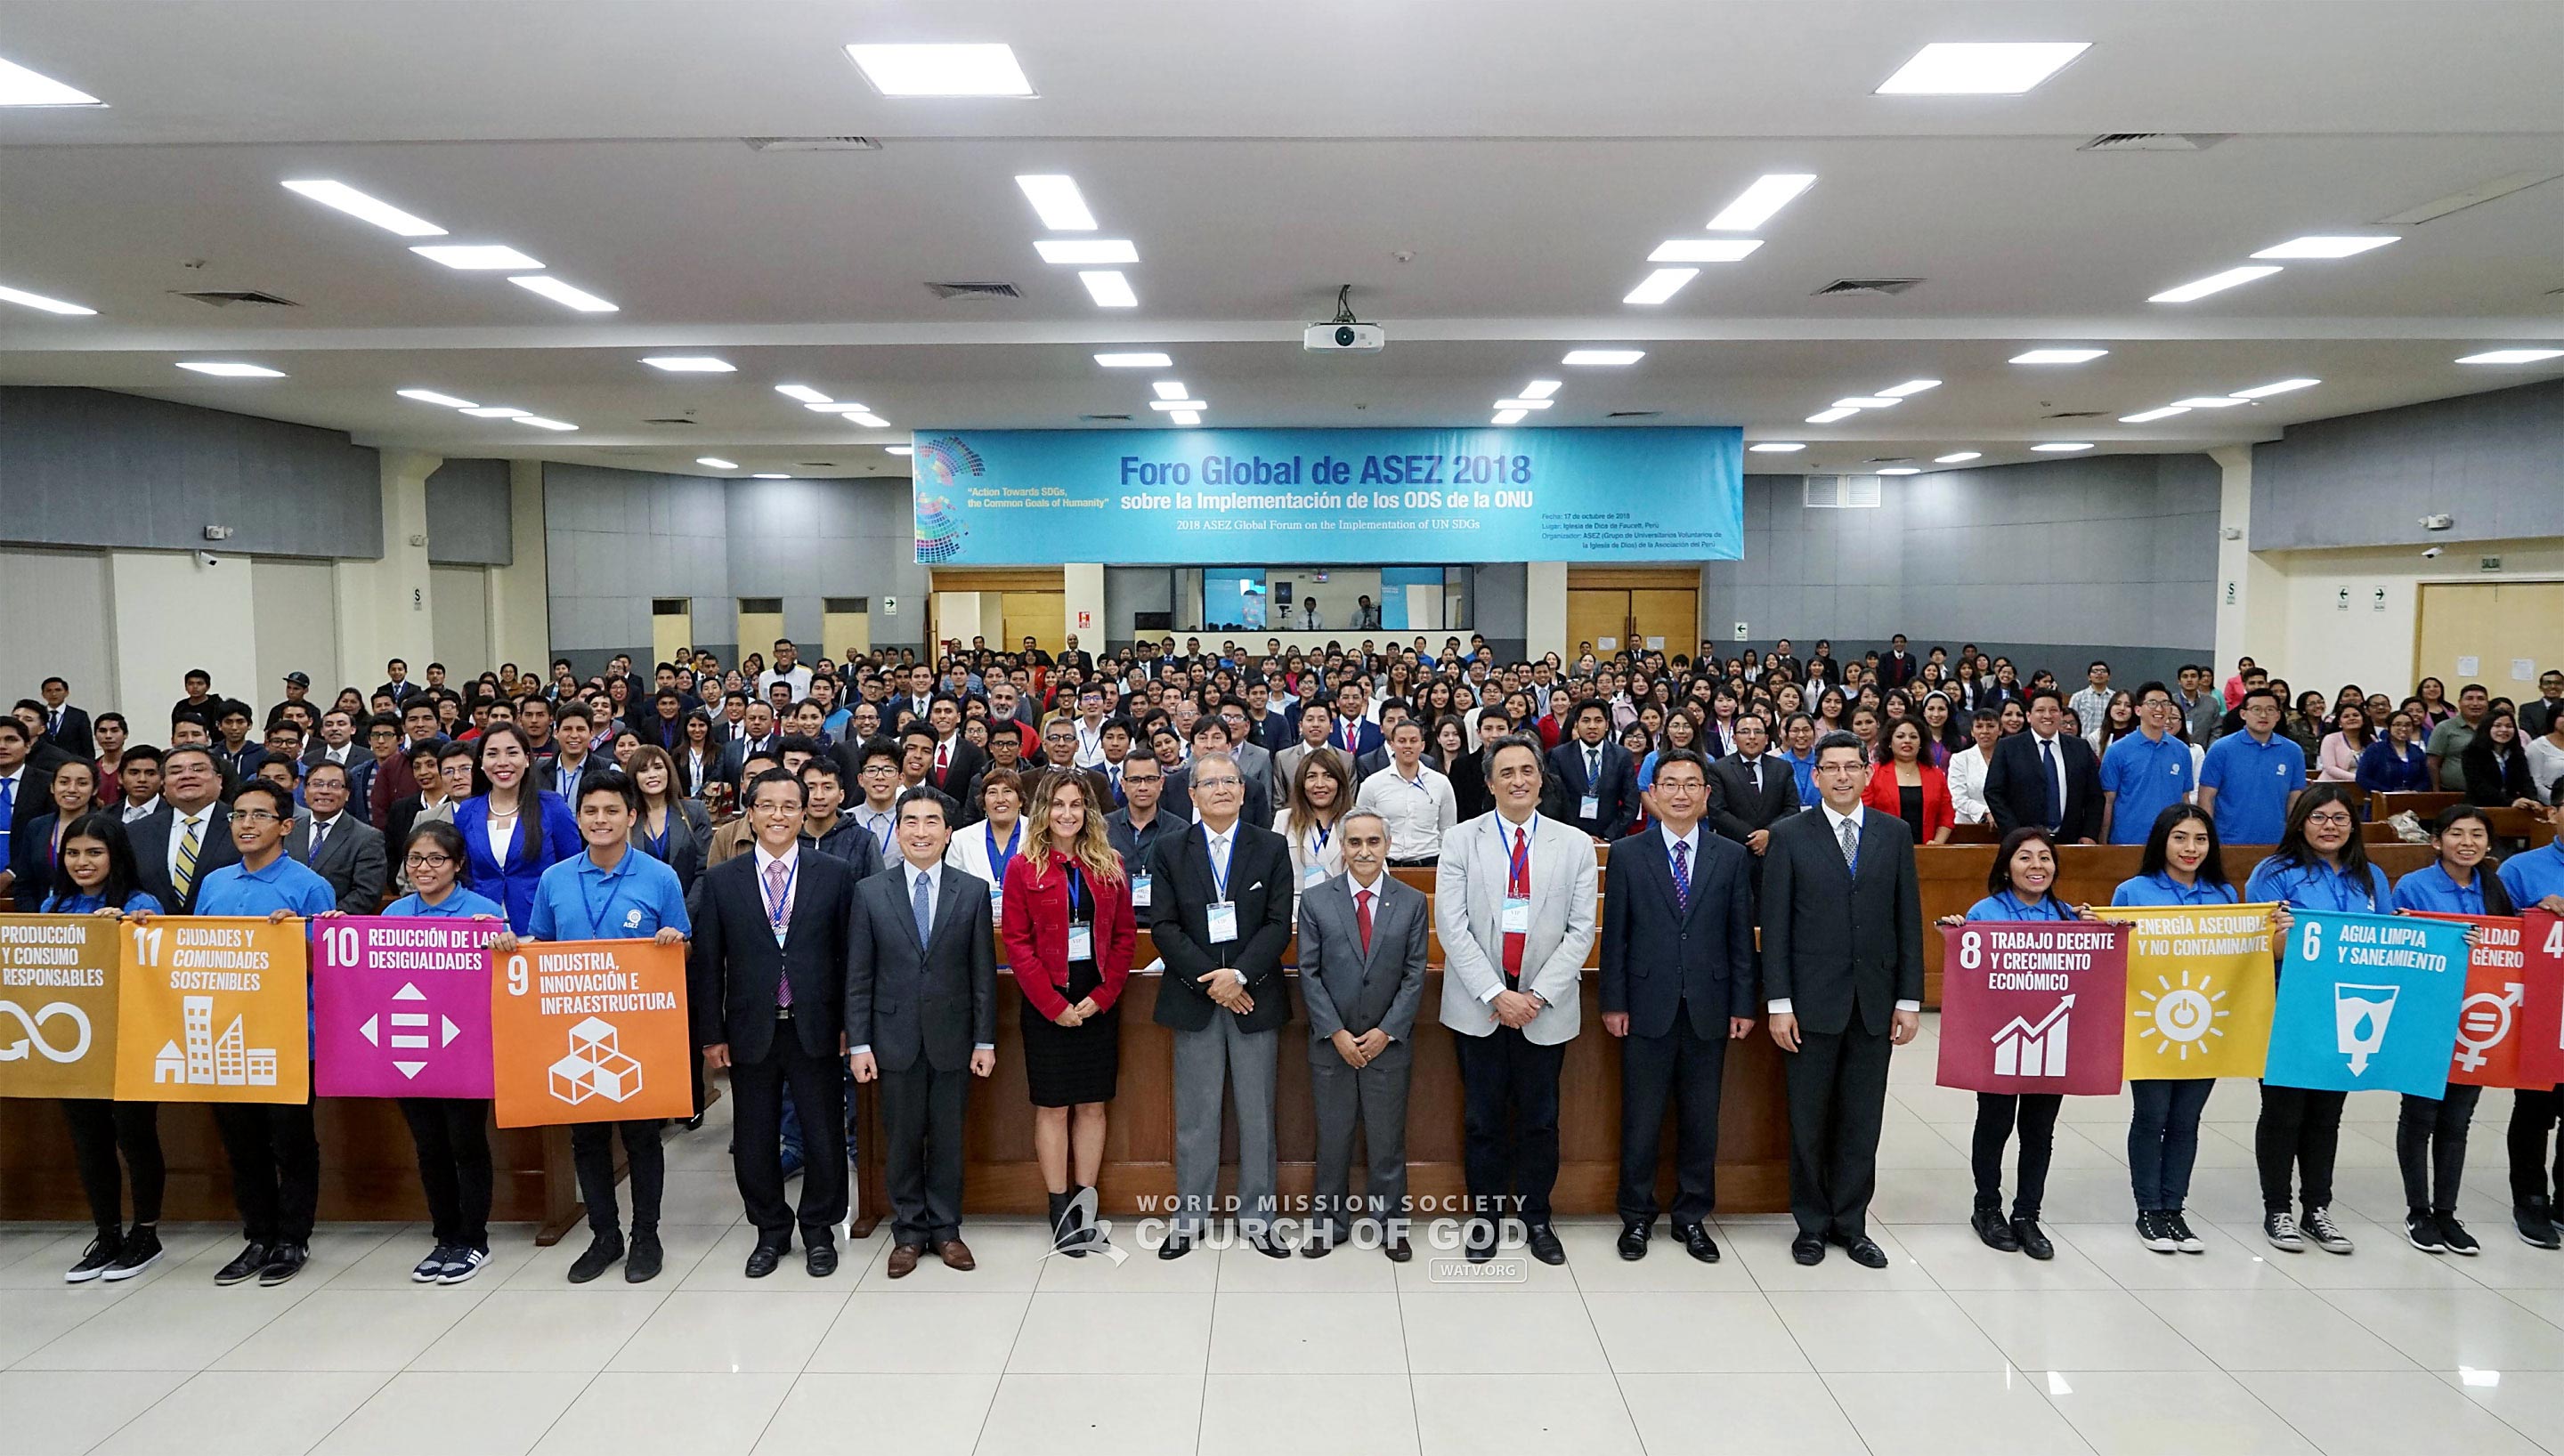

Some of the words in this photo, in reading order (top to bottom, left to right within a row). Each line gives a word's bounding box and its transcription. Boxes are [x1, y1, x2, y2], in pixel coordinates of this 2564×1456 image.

[1121, 457, 1190, 485] Foro
[1202, 456, 1301, 485] Global
[1311, 456, 1350, 485] de
[1359, 455, 1443, 485] ASEZ
[1453, 455, 1531, 484] 2018
[1002, 487, 1039, 497] Towards
[1041, 488, 1067, 497] SDGs,
[1121, 492, 1171, 510] sobre
[1176, 492, 1192, 509] la
[1197, 491, 1341, 513] Implementación
[1346, 491, 1368, 509] de
[1374, 491, 1400, 509] los
[1404, 491, 1442, 508] ODS
[1447, 491, 1468, 508] de
[1473, 491, 1489, 508] la
[1495, 490, 1533, 508] ONU
[968, 498, 982, 508] the
[984, 498, 1023, 508] Common
[1026, 498, 1049, 508] Goals
[1051, 498, 1060, 507] of
[1177, 520, 1200, 530] 2018
[1204, 520, 1231, 530] ASEZ
[1234, 520, 1267, 530] Global
[1270, 520, 1302, 530] Forum
[1305, 522, 1318, 530] on
[1321, 520, 1335, 530] the
[1339, 520, 1416, 531] Implementation
[1418, 519, 1429, 530] of
[1432, 519, 1448, 530] UN
[1452, 519, 1481, 530] SDGs
[415, 588, 421, 601] S
[2228, 583, 2235, 595] S
[1, 924, 86, 944] PRODUCCIÓN
[2137, 915, 2195, 935] ENERGÍA
[2199, 915, 2268, 934] ASEQUIBLE
[134, 926, 164, 967] 11
[176, 927, 242, 947] CIUDADES
[245, 929, 255, 948] Y
[322, 926, 360, 967] 10
[369, 927, 448, 948] REDUCCIÓN
[451, 930, 469, 949] DE
[1990, 932, 2054, 950] TRABAJO
[2057, 933, 2115, 950] DECENTE
[2138, 940, 2147, 956] Y
[2150, 940, 2170, 956] NO
[2173, 935, 2269, 957] CONTAMINANTE
[2302, 921, 2323, 962] 6
[2339, 924, 2377, 944] AGUA
[2380, 926, 2427, 949] LIMPIA
[2543, 920, 2564, 959] 4
[2, 947, 11, 964] Y
[14, 947, 78, 966] CONSUMO
[173, 949, 270, 970] COMUNIDADES
[369, 950, 483, 971] DESIGUALDADES
[1960, 931, 1982, 969] 8
[2338, 946, 2349, 963] Y
[2350, 947, 2447, 973] SANEAMIENTO
[2471, 946, 2525, 968] GÉNERO
[539, 951, 620, 973] INDUSTRIA,
[1990, 952, 2000, 970] Y
[2003, 952, 2091, 970] CRECIMIENTO
[3, 968, 104, 987] RESPONSABLES
[170, 971, 261, 991] SOSTENIBLES
[507, 955, 530, 997] 9
[540, 971, 627, 993] INNOVACIÓN
[630, 973, 639, 991] E
[1989, 971, 2069, 991] ECONÓMICO
[540, 991, 677, 1015] INFRAESTRUCTURA
